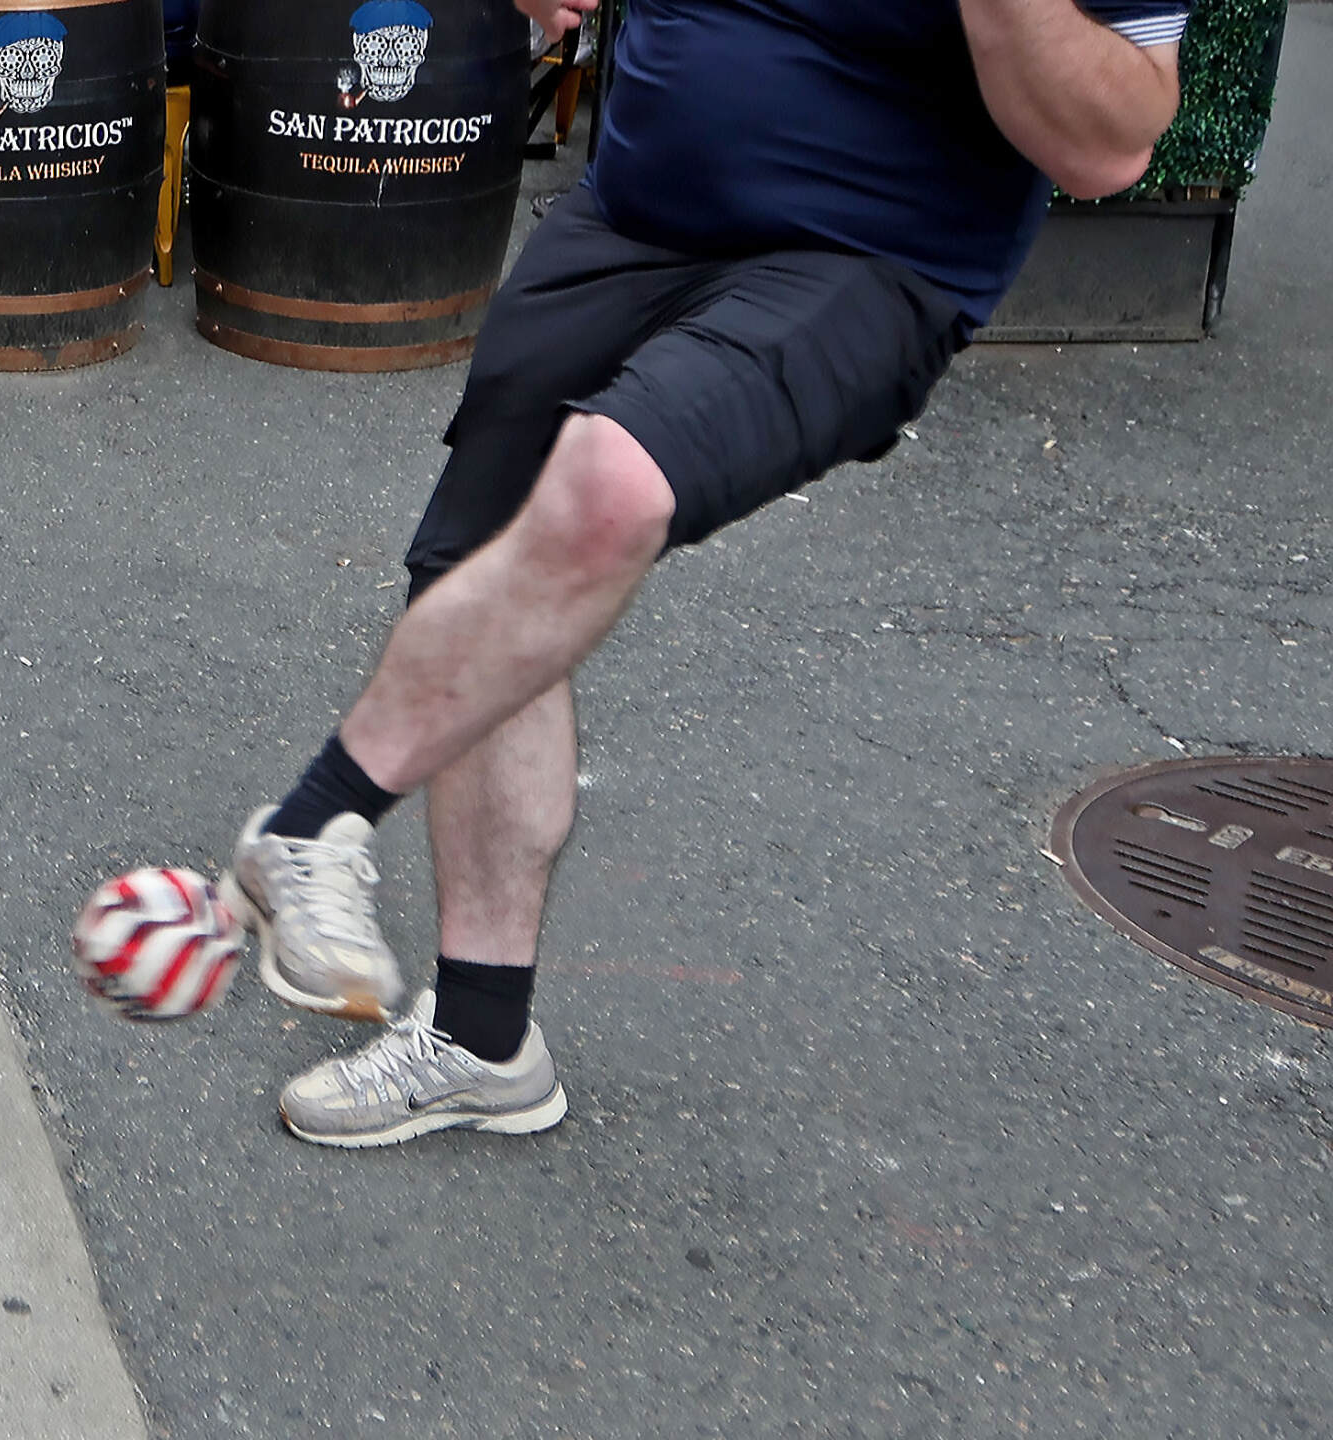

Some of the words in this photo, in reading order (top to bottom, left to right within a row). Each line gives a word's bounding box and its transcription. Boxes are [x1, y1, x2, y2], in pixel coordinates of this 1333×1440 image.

[267, 109, 326, 140] SAN
[26, 155, 105, 181] WHISKEY
[300, 152, 380, 174] TEQUILA
[383, 153, 466, 174] WHISKEY
